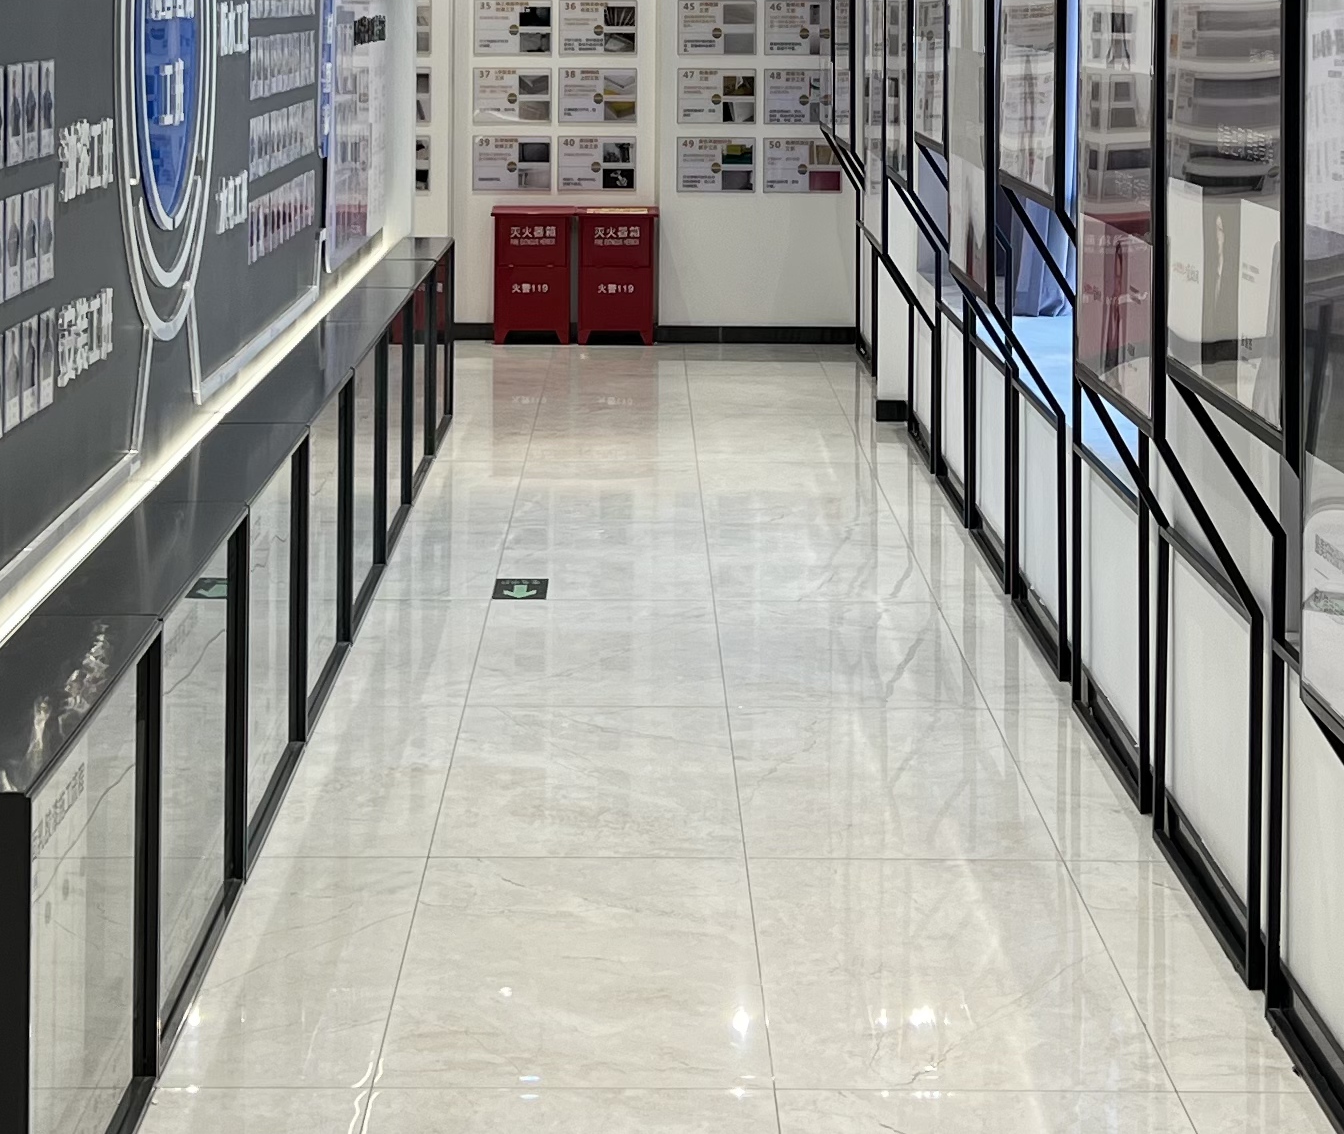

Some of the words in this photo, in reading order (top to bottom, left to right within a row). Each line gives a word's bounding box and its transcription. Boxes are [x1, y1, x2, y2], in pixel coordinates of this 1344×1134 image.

[480, 2, 491, 10] 35
[565, 2, 576, 10] 36
[683, 2, 695, 10] 45
[770, 3, 782, 11] 46
[480, 70, 491, 79] 37
[564, 70, 576, 79] 38
[683, 71, 695, 80] 47
[770, 72, 782, 81] 48
[479, 138, 491, 147] 39
[563, 138, 575, 147] 40
[682, 139, 694, 148] 49
[769, 140, 781, 149] 50
[511, 227, 556, 238] 灭火器箱
[595, 227, 640, 238] 灭火器箱
[512, 284, 549, 294] 火警119
[598, 284, 635, 294] 火警119
